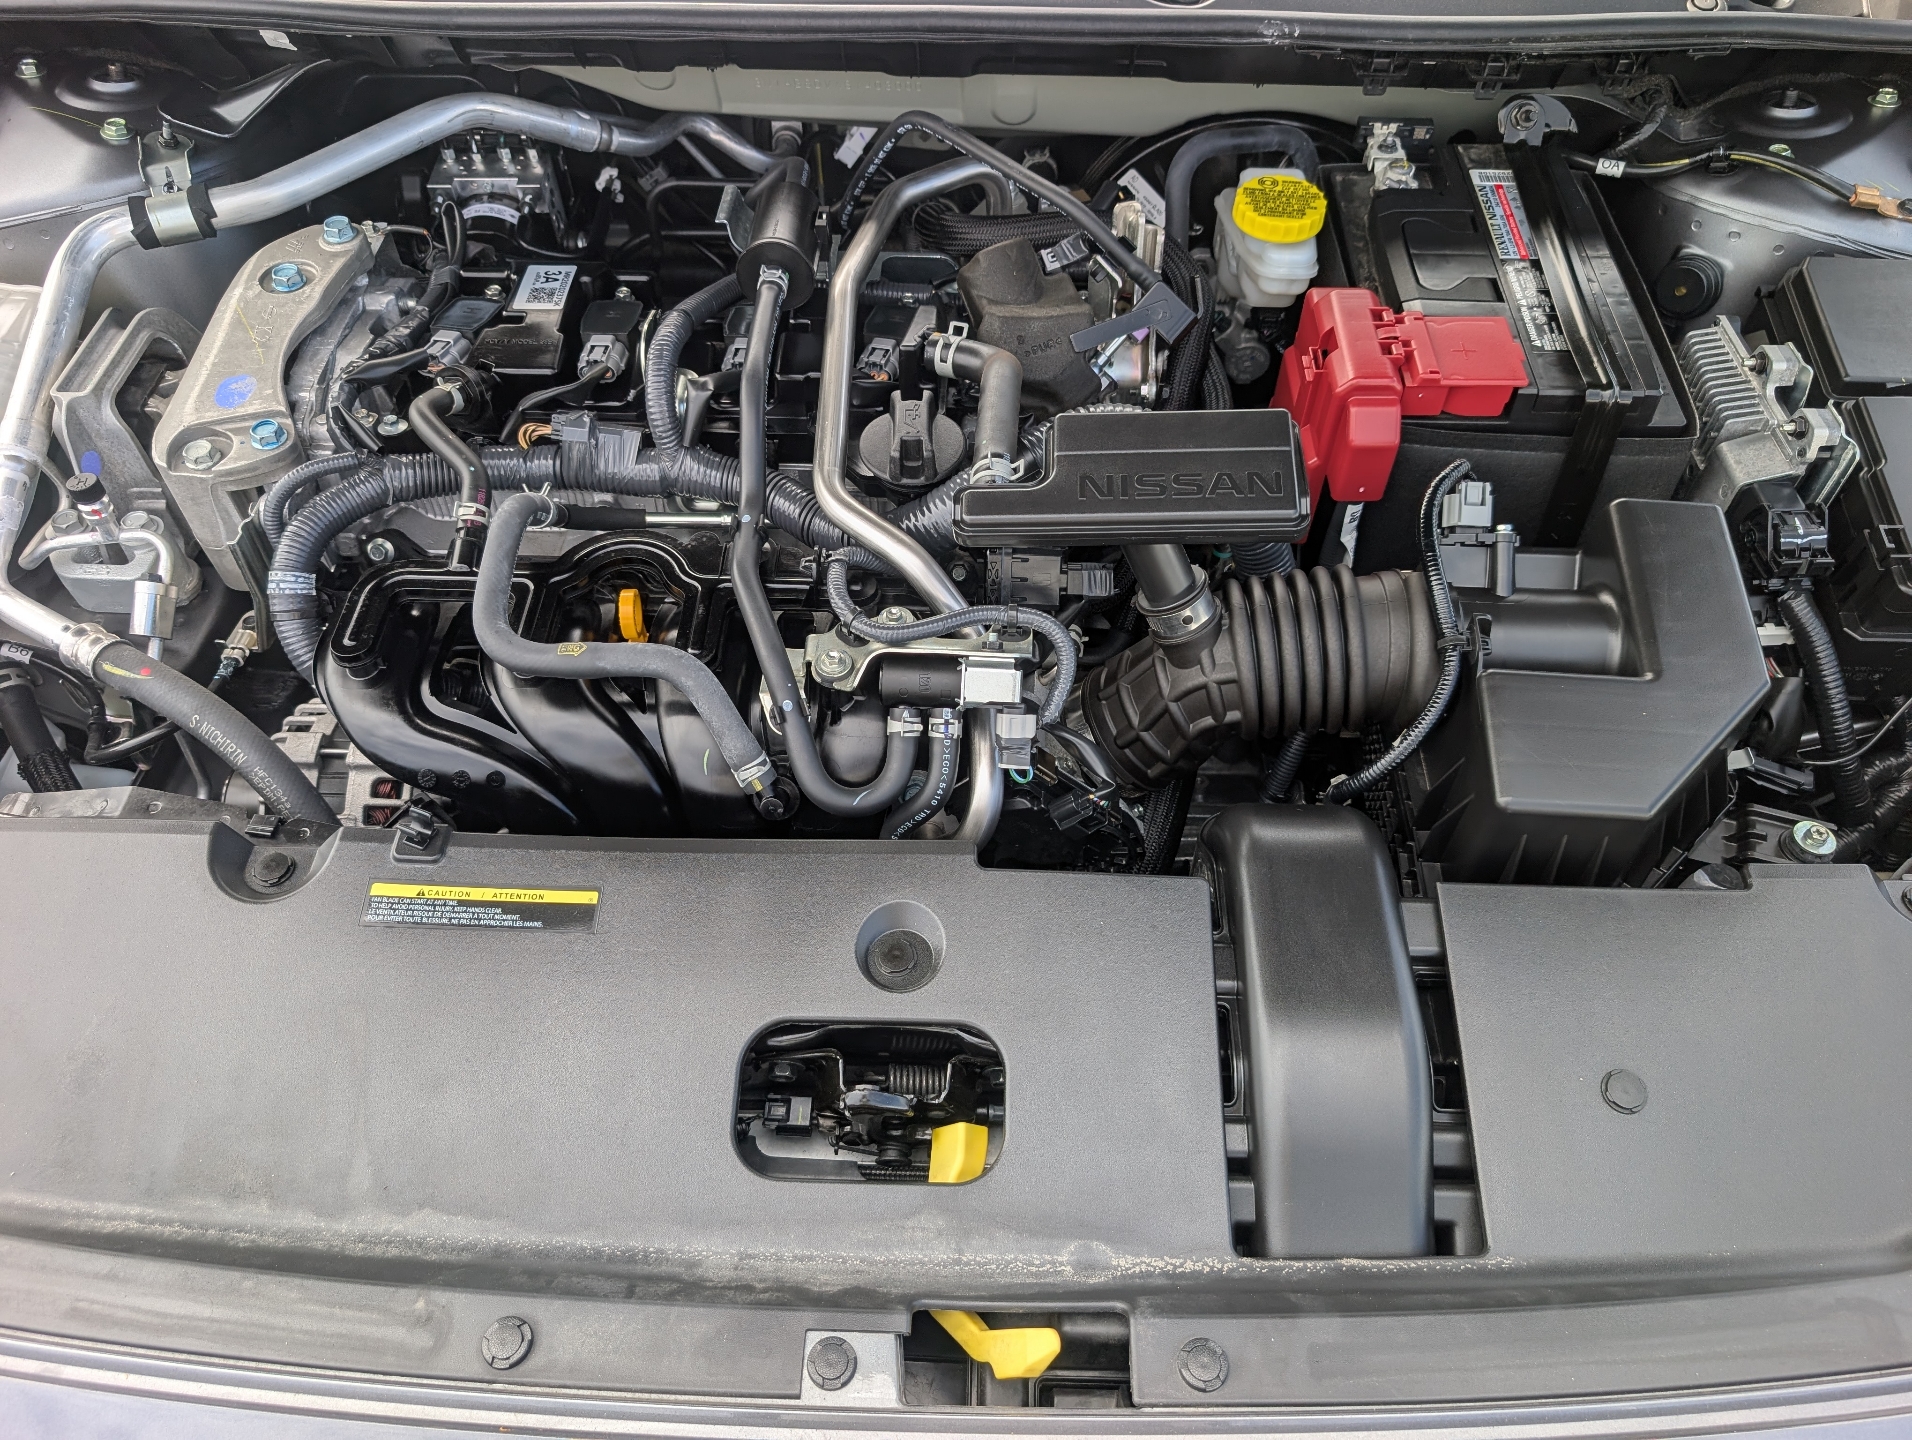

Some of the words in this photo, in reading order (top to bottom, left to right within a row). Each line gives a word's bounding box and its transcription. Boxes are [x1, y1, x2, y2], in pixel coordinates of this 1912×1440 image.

[1477, 186, 1498, 220] NISSAN
[1490, 223, 1512, 256] RENAULT
[540, 270, 562, 284] 3A
[1078, 471, 1284, 500] NISSAN
[427, 890, 471, 898] CAUTION
[492, 892, 545, 900] ATTENTION
